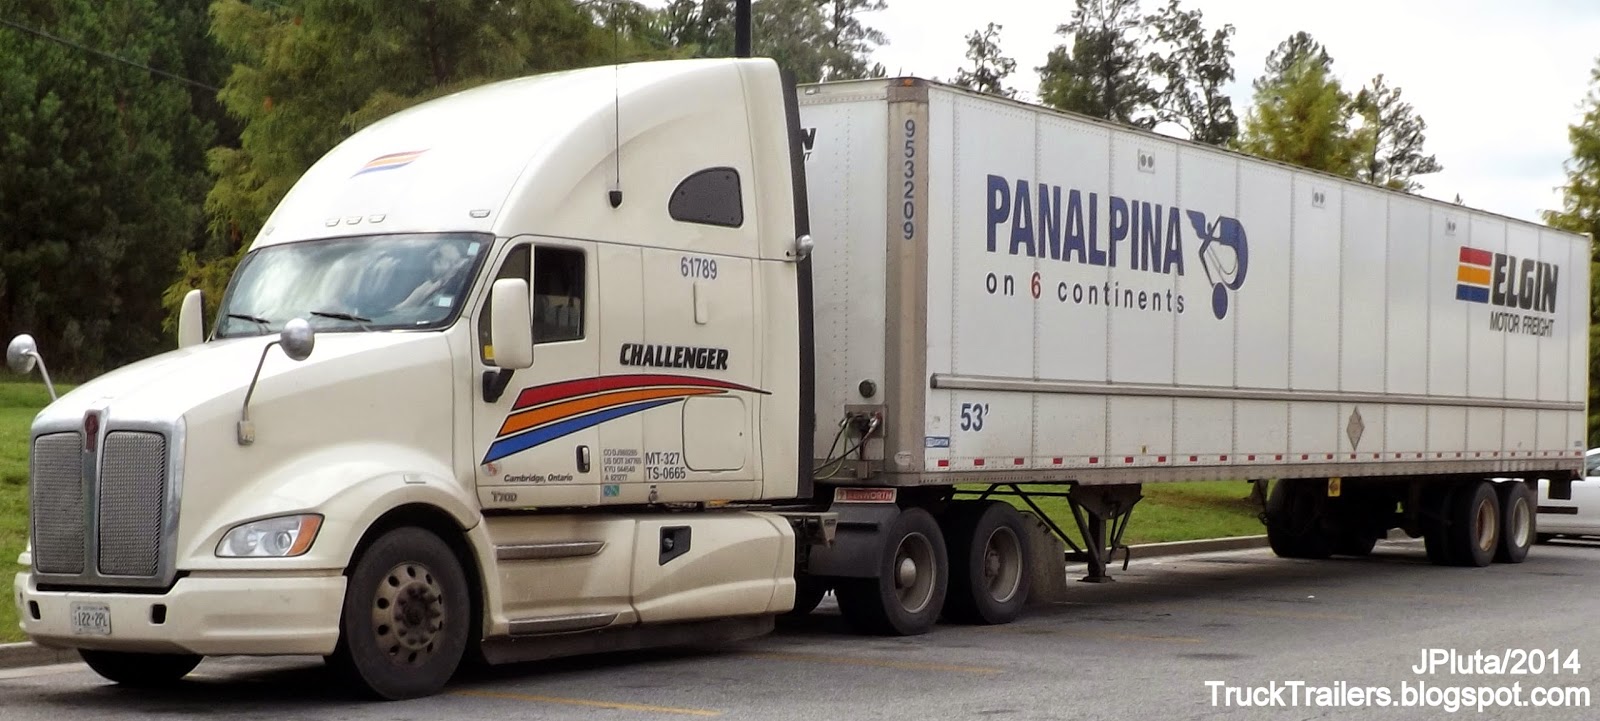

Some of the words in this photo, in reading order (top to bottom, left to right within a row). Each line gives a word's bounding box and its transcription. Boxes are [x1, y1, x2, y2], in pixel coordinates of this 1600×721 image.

[902, 118, 916, 241] 953209
[986, 173, 1185, 276] PANALPINA
[680, 256, 718, 280] 61789
[986, 271, 1015, 297] on
[1030, 270, 1042, 300] 6
[1057, 279, 1185, 314] continents
[1491, 252, 1559, 314] ELGIN
[1489, 310, 1520, 334] MOTOR
[1522, 315, 1555, 338] FREIGHT
[619, 343, 729, 370] CHALLENGER
[645, 452, 680, 465] MT-327
[503, 474, 546, 484] Cambridge,
[547, 473, 573, 482] Ontario
[646, 467, 686, 480] TS-0665
